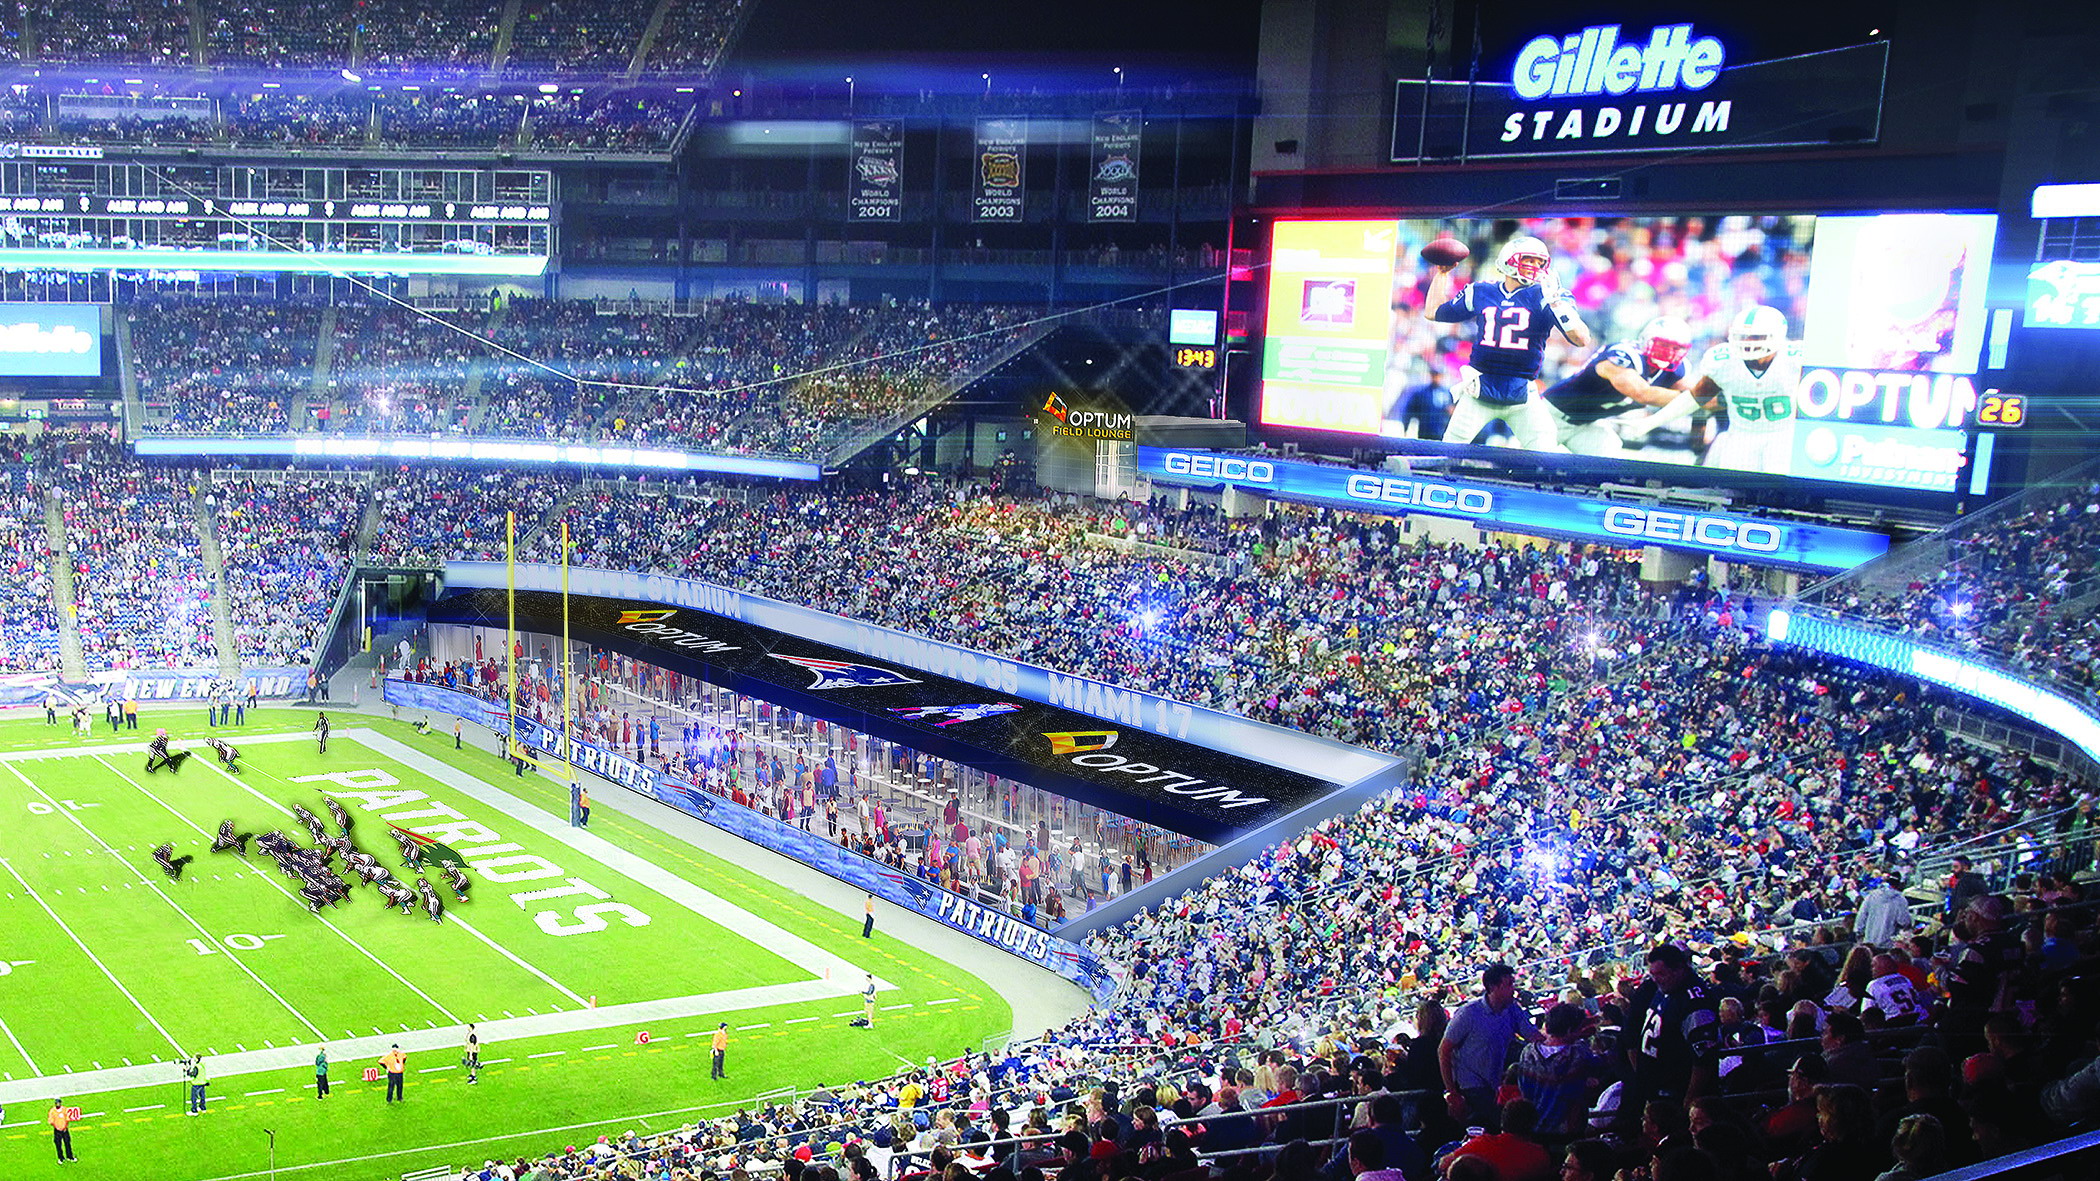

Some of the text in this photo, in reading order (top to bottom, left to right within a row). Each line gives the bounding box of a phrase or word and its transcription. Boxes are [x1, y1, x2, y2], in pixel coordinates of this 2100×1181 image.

[1511, 22, 1727, 101] Gillette
[1500, 100, 1732, 143] STADIUM
[859, 207, 891, 218] 2001
[980, 206, 1015, 218] 2003
[1095, 206, 1129, 218] 2004
[1478, 306, 1530, 350] 12
[1069, 411, 1131, 430] OPTUM
[1980, 397, 2022, 423] 26
[1052, 426, 1132, 438] FIELD LOUNGE
[1164, 453, 1274, 483] GEICO
[1346, 474, 1494, 514] GEICO
[1603, 506, 1782, 551] GEICO
[646, 575, 741, 619] STADIUM
[625, 622, 742, 653] OPTUM
[123, 677, 177, 699] NEW
[984, 658, 1018, 694] 35
[1047, 673, 1143, 728] MIAMI
[1155, 700, 1192, 740] 17
[541, 727, 655, 793] PATRIOTS
[1071, 754, 1270, 809] OPTUM
[285, 767, 652, 937] PATRIOTS
[937, 891, 1050, 959] PATRIOTS
[186, 933, 266, 956] 10
[640, 1032, 649, 1043] G
[366, 1068, 377, 1081] 10
[66, 1108, 79, 1121] 20
